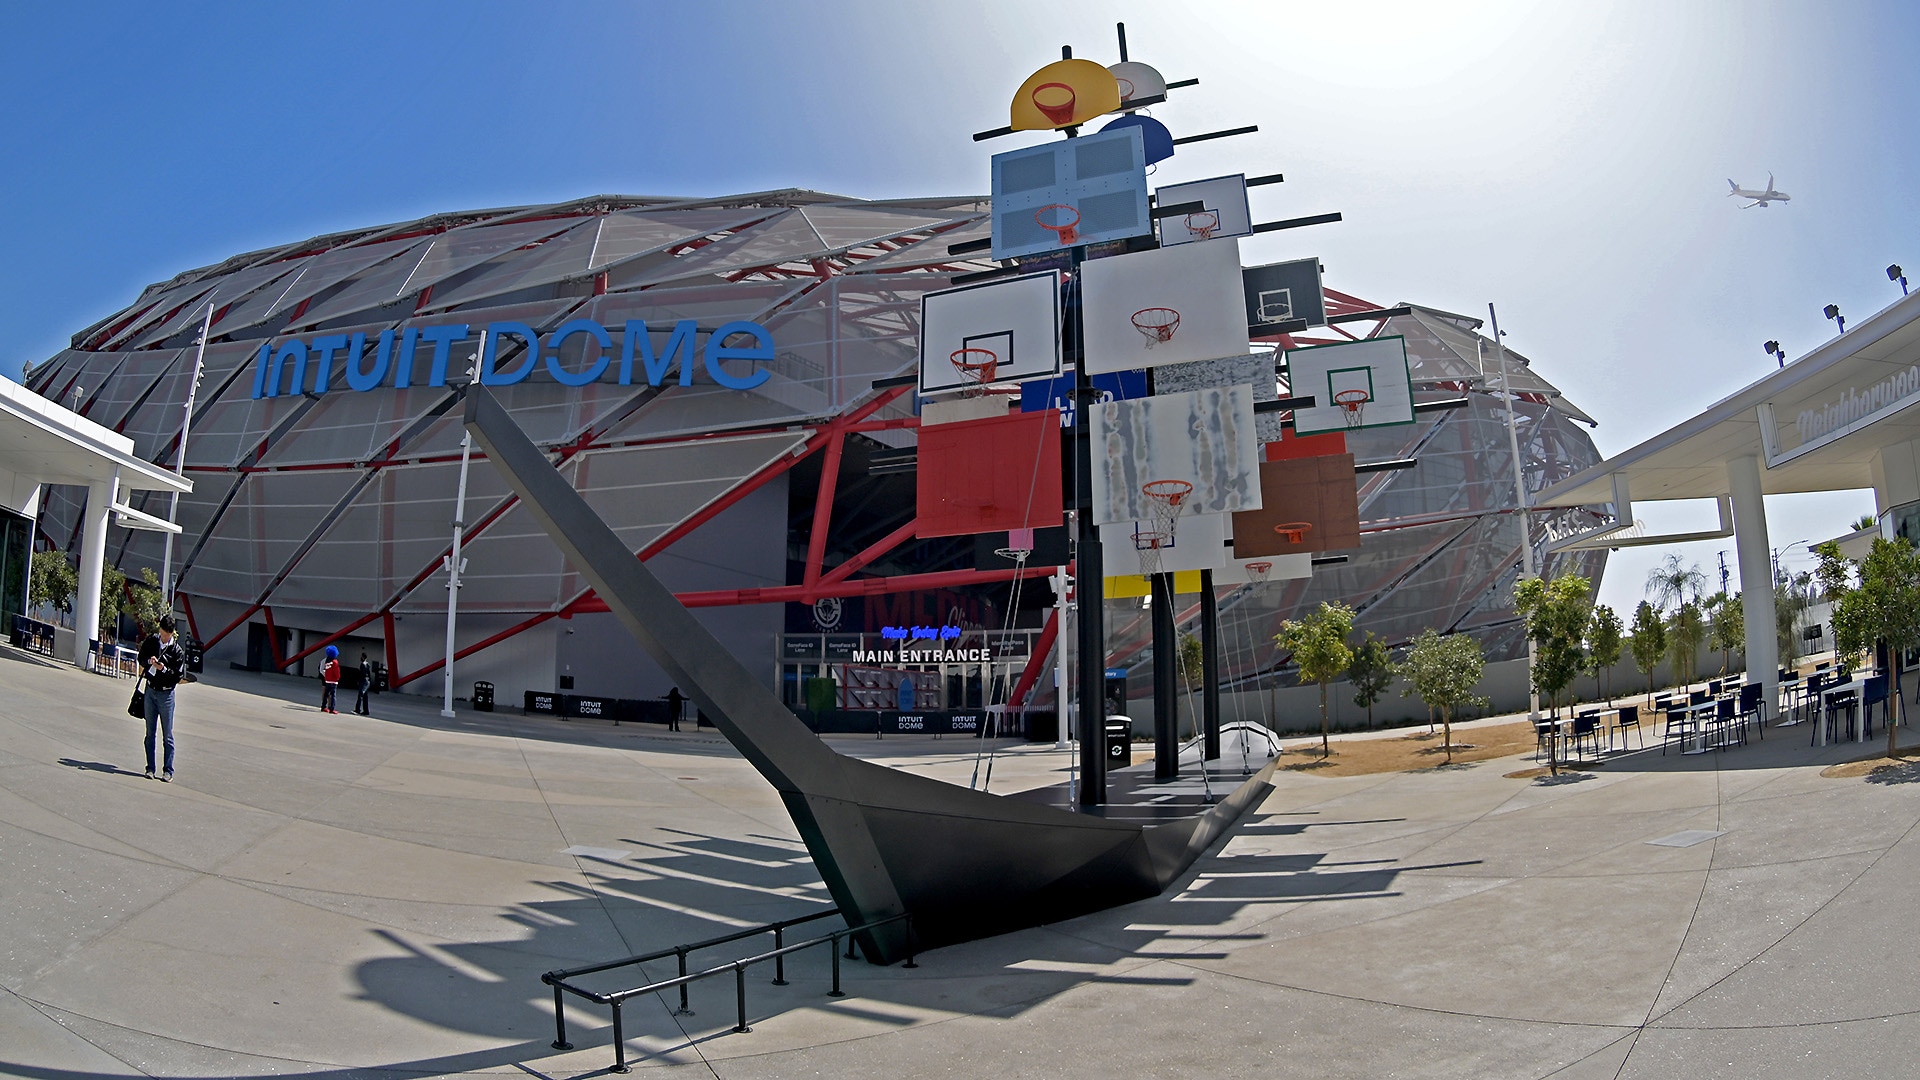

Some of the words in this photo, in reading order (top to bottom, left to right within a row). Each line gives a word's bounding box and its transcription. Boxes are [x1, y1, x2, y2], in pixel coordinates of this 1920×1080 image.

[1796, 365, 1920, 445] Neighborwoo
[910, 625, 938, 641] Today
[852, 650, 894, 663] MAIN
[900, 648, 991, 662] ENTRANCE
